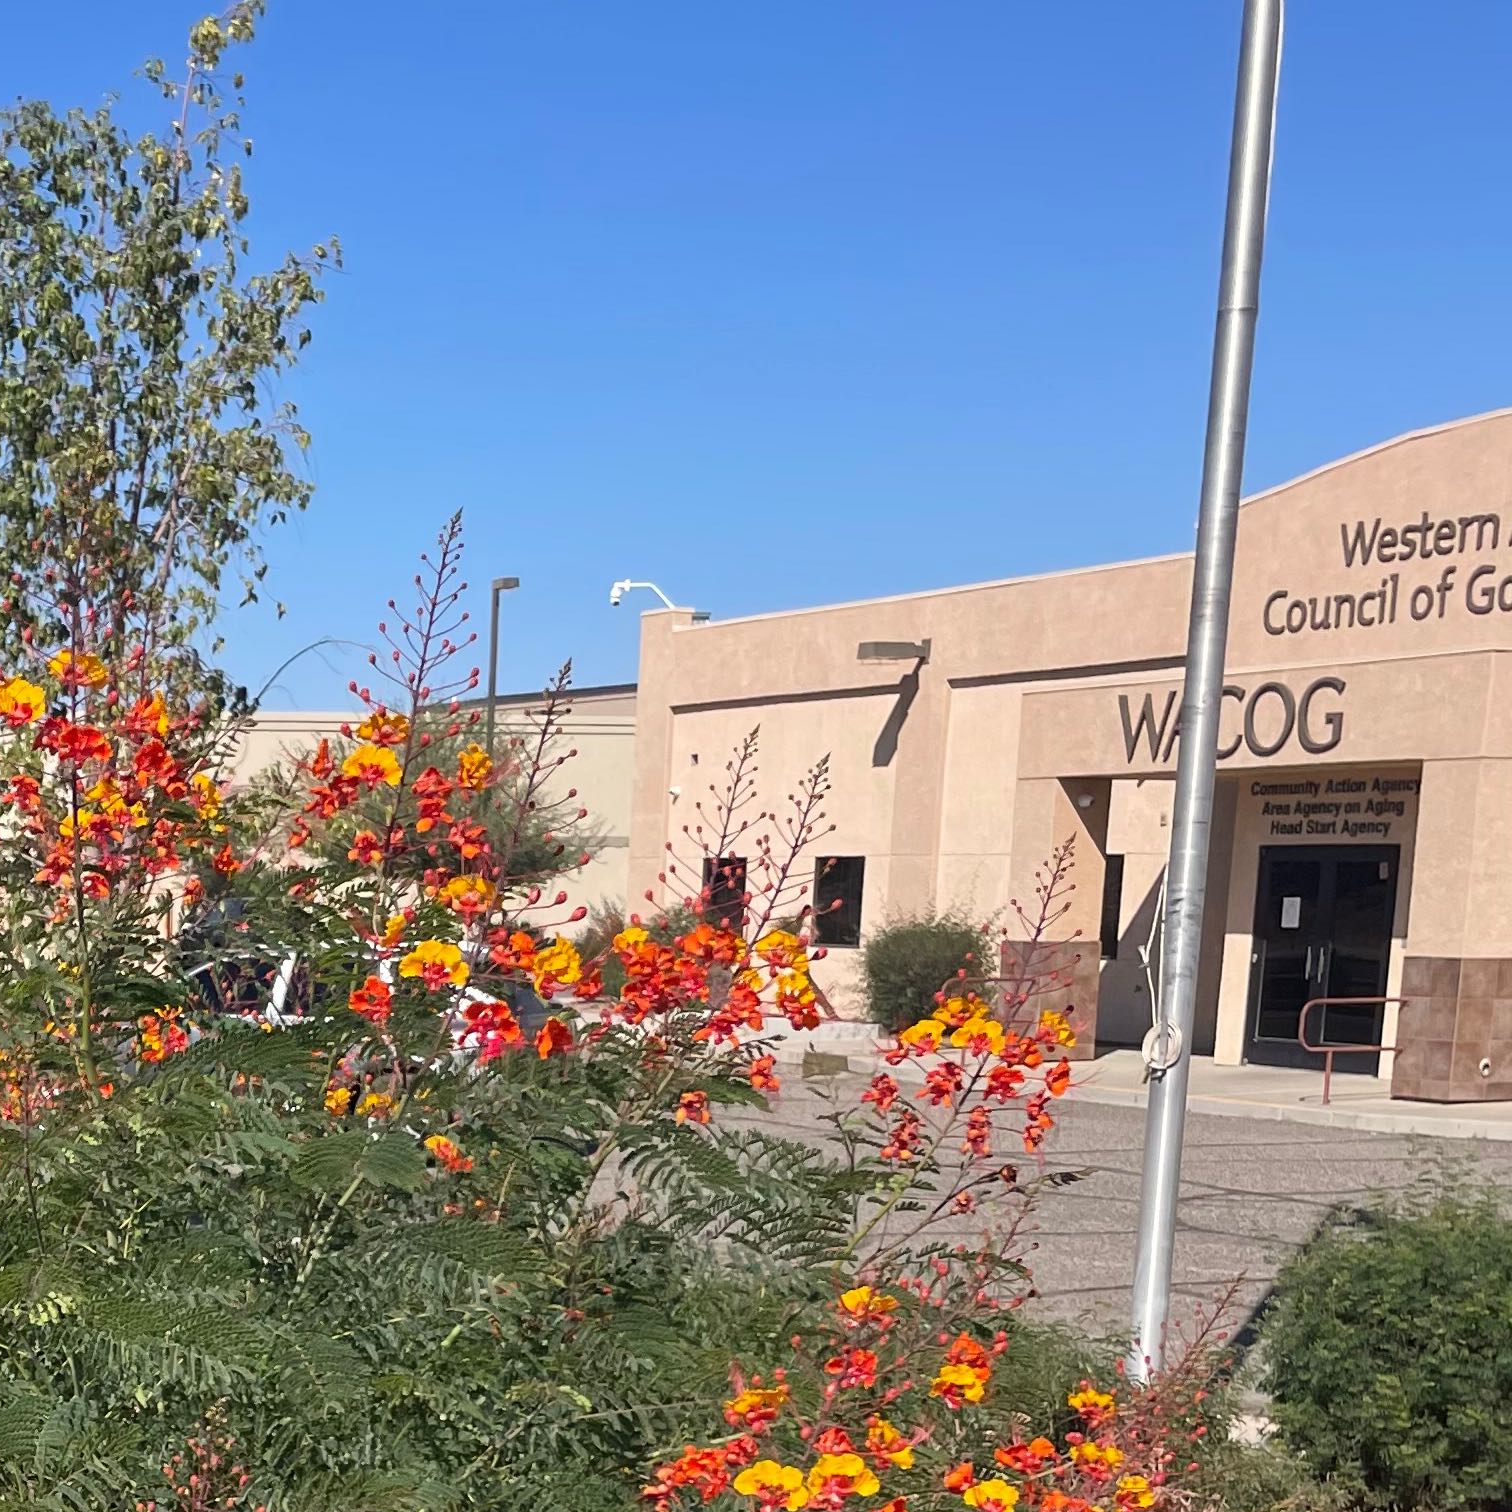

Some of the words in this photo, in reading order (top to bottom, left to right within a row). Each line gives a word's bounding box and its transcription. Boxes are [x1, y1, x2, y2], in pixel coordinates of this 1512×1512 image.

[1341, 511, 1500, 567] Western
[1263, 573, 1400, 635] Council
[1410, 565, 1457, 621] of
[1251, 780, 1321, 797] Community
[1325, 778, 1366, 794] Action
[1371, 777, 1421, 795] Agency
[1262, 801, 1290, 816] Area
[1294, 800, 1342, 817] Agency
[1344, 803, 1360, 814] on
[1364, 799, 1405, 816] Aging
[1270, 820, 1303, 835] Head
[1306, 819, 1337, 835] Start
[1340, 819, 1391, 837] Agency
